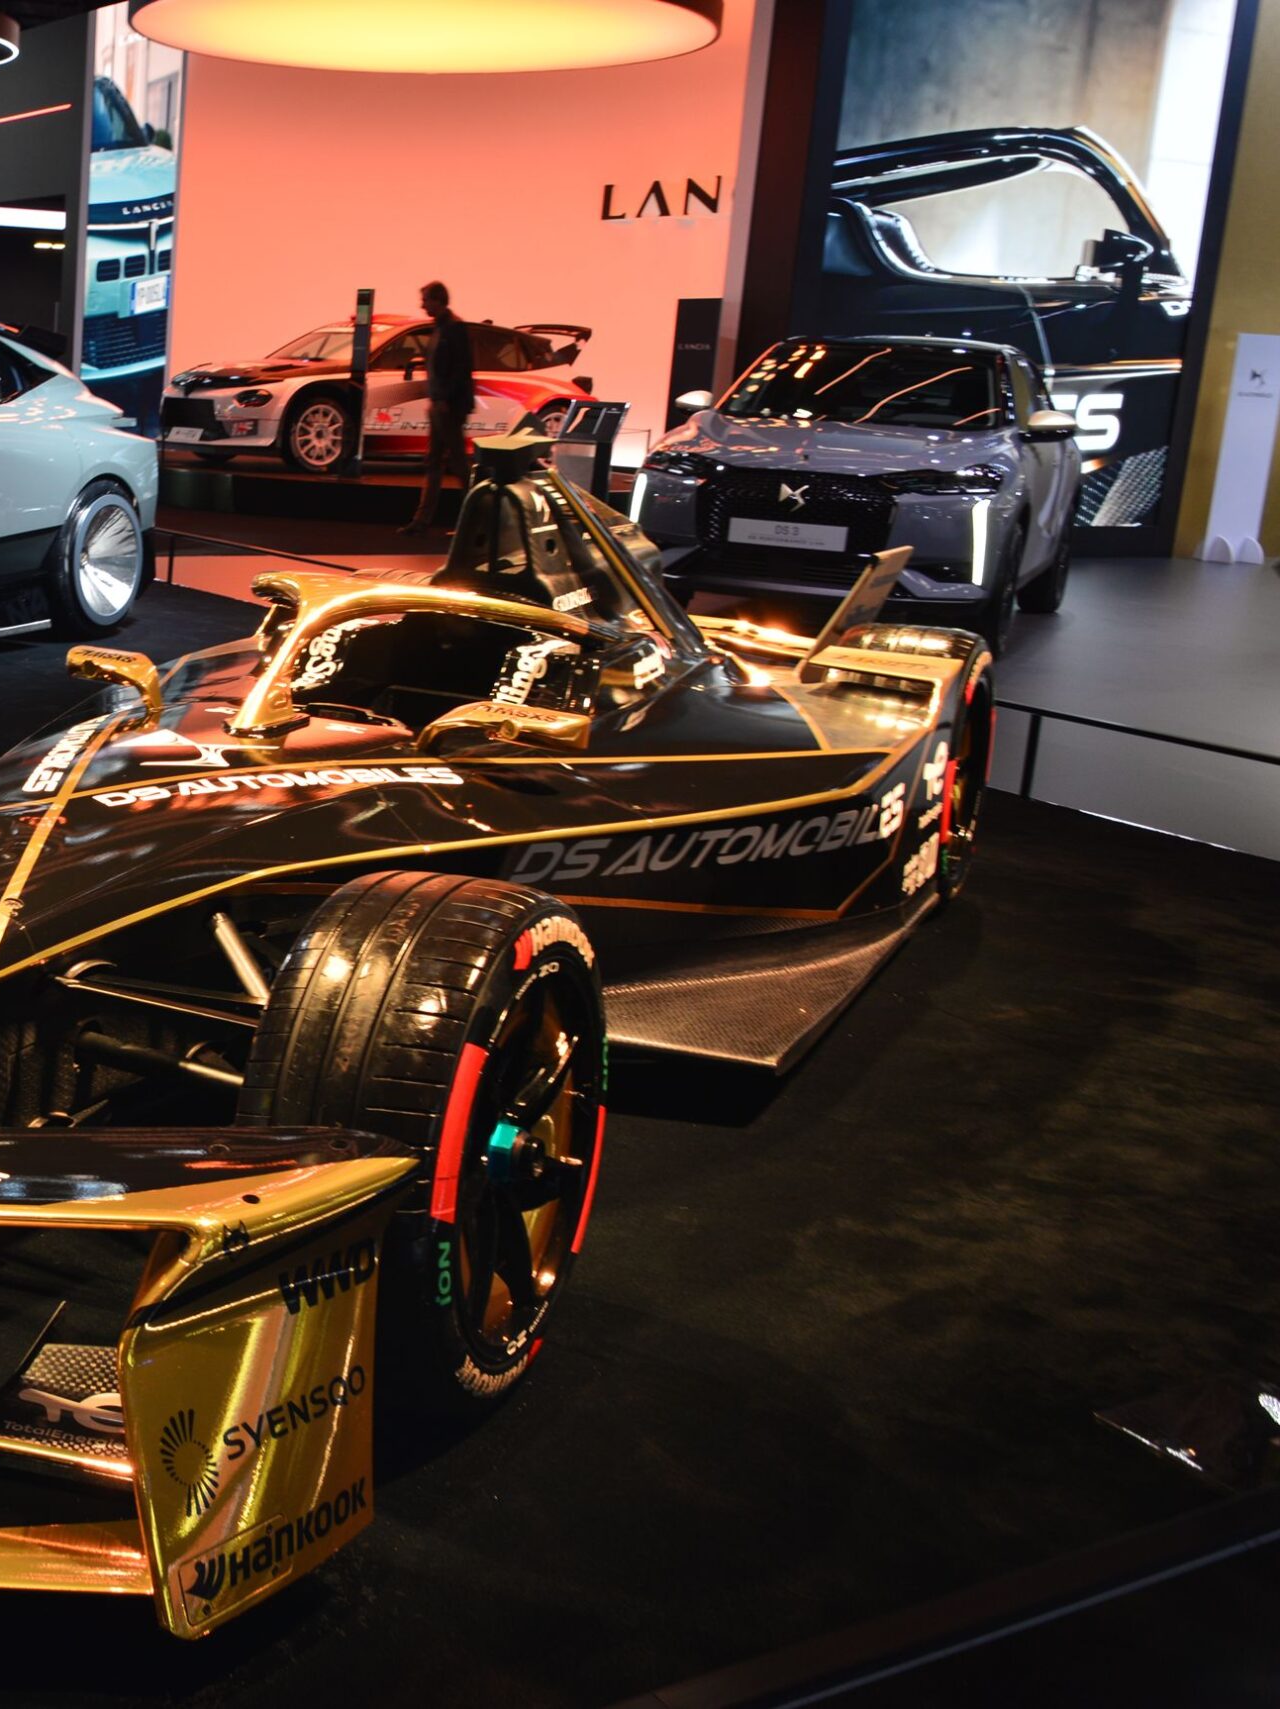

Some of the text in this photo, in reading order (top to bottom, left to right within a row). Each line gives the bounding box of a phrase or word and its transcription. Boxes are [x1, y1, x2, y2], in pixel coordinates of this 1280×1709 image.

[792, 525, 800, 536] 3
[92, 766, 464, 808] DS AUTOMOBILES
[508, 839, 613, 883] DS
[601, 782, 906, 877] AUTOMOBILES
[278, 1238, 377, 1315] WWD
[223, 1363, 366, 1461] SYENSQO
